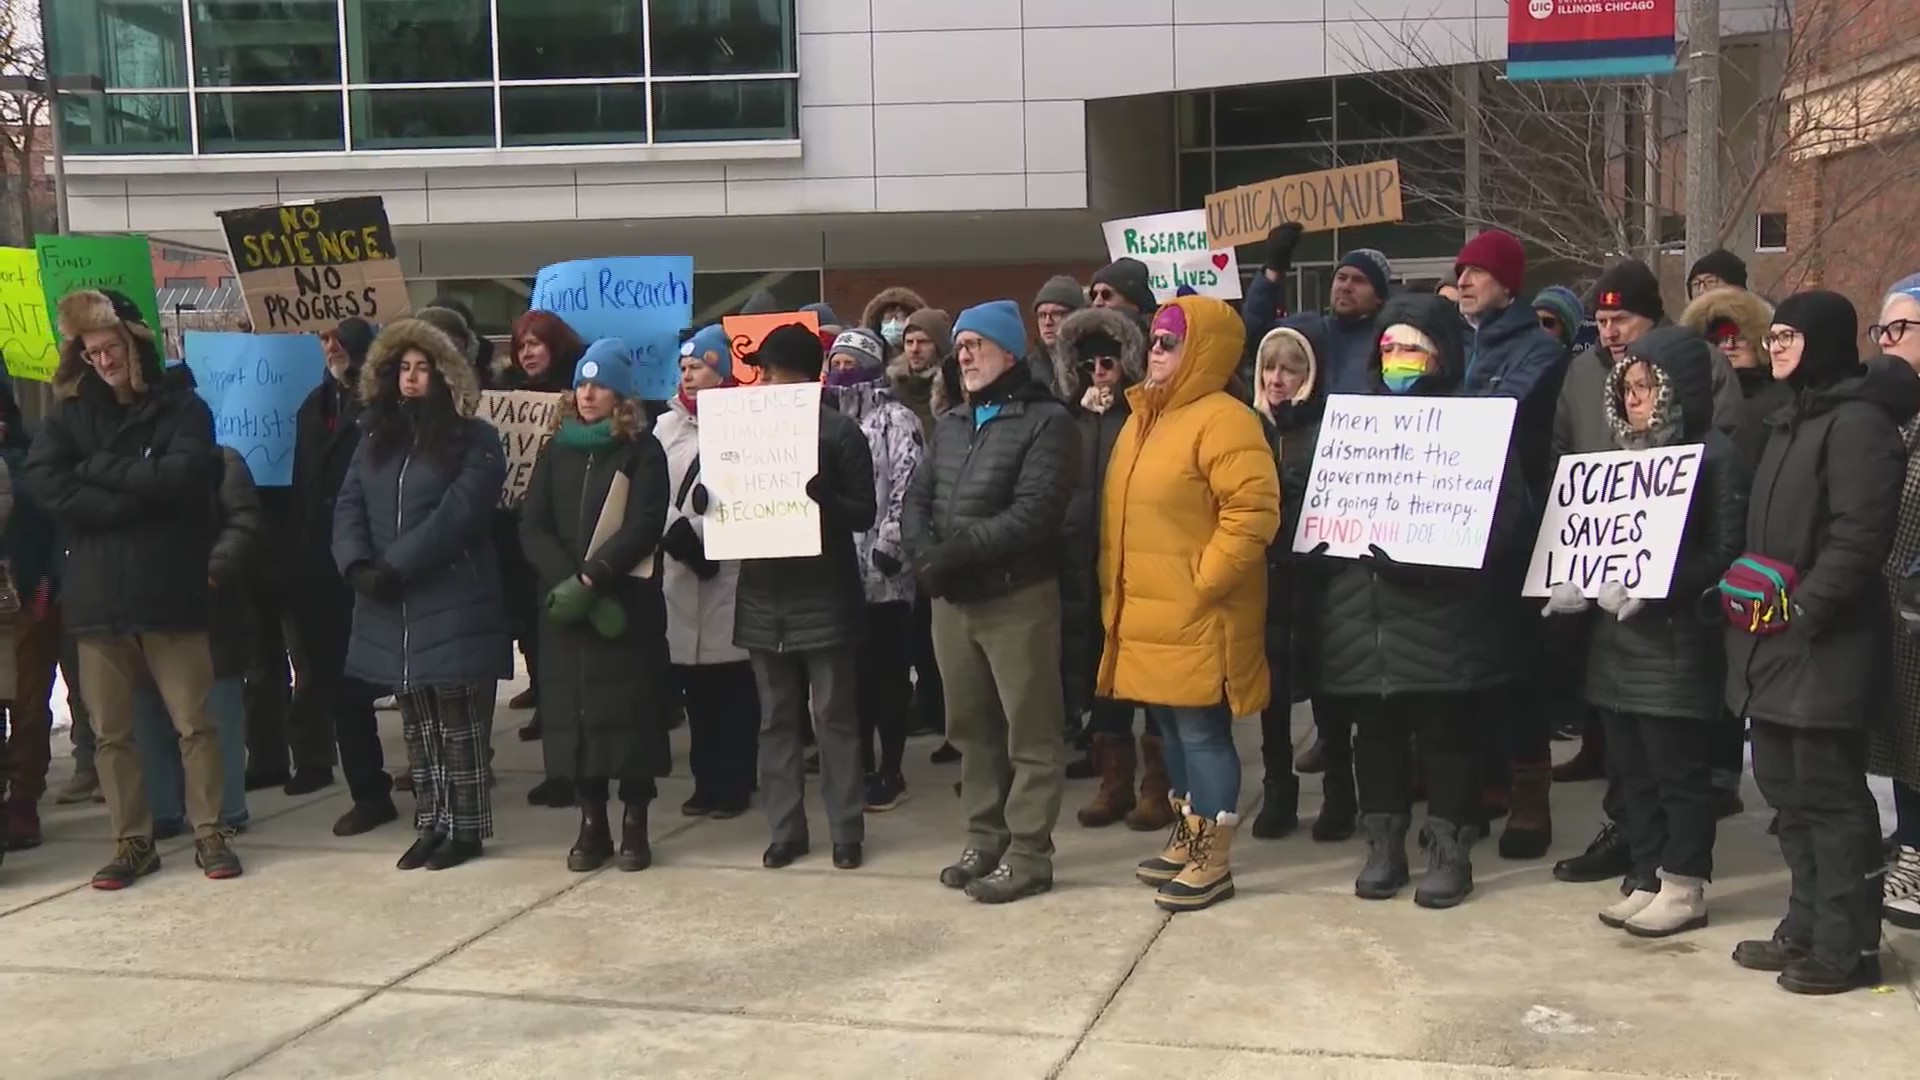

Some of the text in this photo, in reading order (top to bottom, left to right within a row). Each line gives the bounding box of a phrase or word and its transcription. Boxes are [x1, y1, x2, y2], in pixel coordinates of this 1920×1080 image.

[1531, 2, 1551, 12] UIC
[1558, 0, 1655, 14] ILLINOIS CHICAGO
[279, 206, 320, 234] NO
[1124, 228, 1208, 254] RESEARCH
[294, 266, 341, 297] NO
[1173, 262, 1218, 287] LIVES
[540, 267, 689, 313] Fund Research
[264, 286, 377, 329] PROGRESS
[256, 358, 290, 386] Our
[1330, 407, 1442, 434] men will
[1321, 438, 1460, 467] dismantle the
[745, 471, 802, 492] HEART
[1316, 468, 1494, 493] government instead
[1558, 453, 1697, 508] SCIENCE
[1311, 491, 1478, 526] of going to therapy.
[1304, 516, 1364, 544] FUND
[1369, 522, 1400, 543] NIH
[1406, 523, 1437, 544] DOE
[1561, 510, 1648, 548] SAVES
[1545, 549, 1652, 589] LIVES
